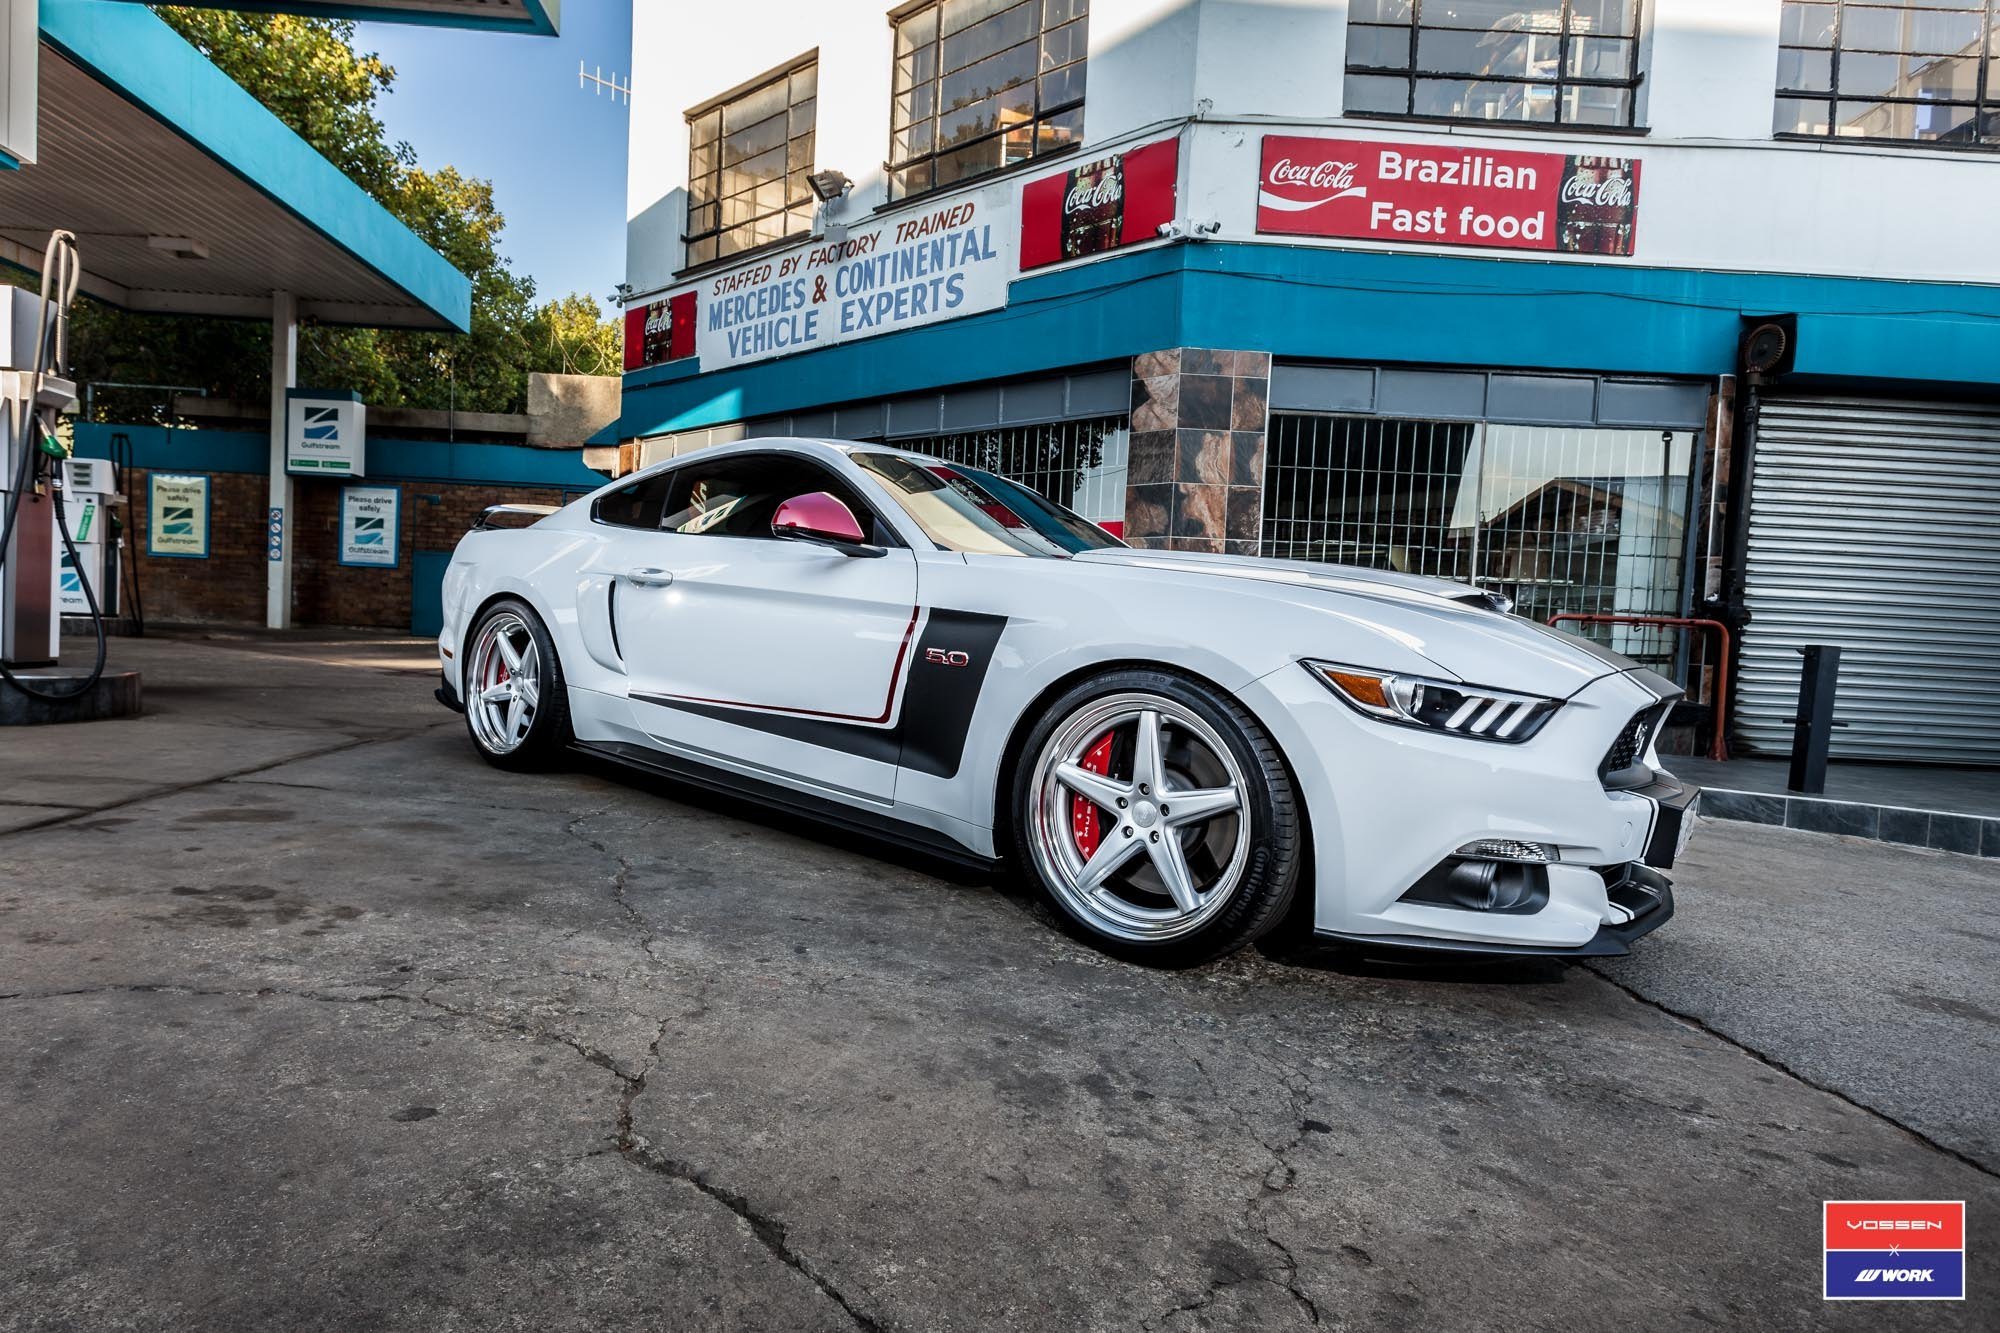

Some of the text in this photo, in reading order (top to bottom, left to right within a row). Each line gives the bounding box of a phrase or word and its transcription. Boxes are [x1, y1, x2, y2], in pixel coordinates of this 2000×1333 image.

[1269, 158, 1358, 189] Coca-Cola
[1378, 150, 1537, 190] Brazilian
[1370, 201, 1545, 241] Fast food
[713, 202, 975, 296] STAFFED BY FACTORY TRAINED
[709, 224, 997, 332] MERCEDES & CONTINENTAL
[728, 272, 964, 358] VEHICLE EXPERTS
[301, 442, 341, 450] Gulfstream
[156, 485, 180, 493] Please
[359, 505, 381, 513] safely
[374, 496, 392, 504] drive
[157, 537, 199, 545] Gulfstream
[348, 546, 389, 555] Gulfstream
[925, 648, 969, 666] 5.0
